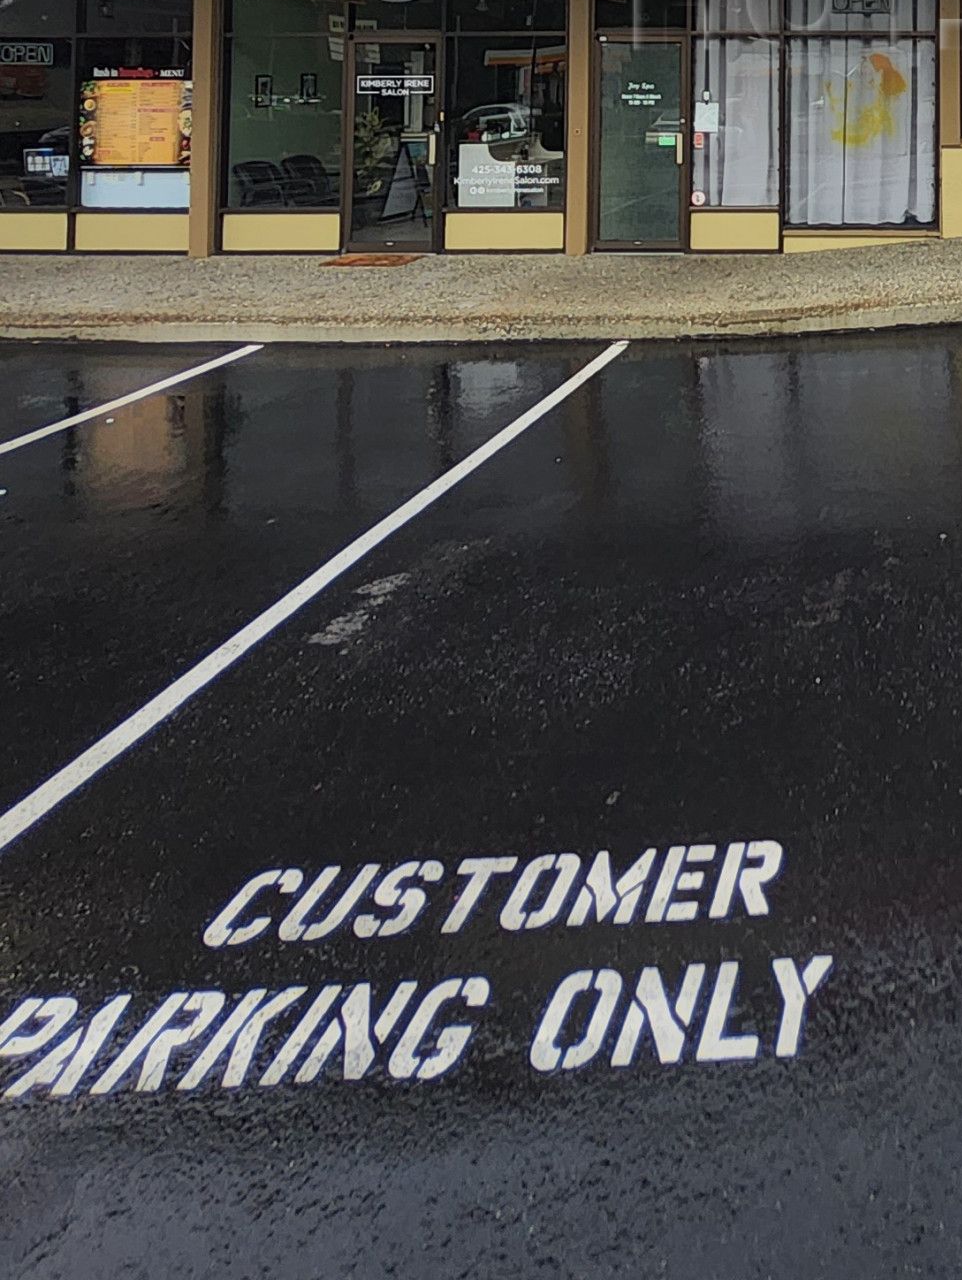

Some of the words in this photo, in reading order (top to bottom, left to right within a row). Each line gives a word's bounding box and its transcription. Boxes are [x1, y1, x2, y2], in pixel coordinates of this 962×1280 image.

[1, 45, 50, 63] OPEN
[160, 68, 185, 77] MENU
[360, 79, 402, 88] KIMBERLY
[403, 79, 430, 88] IRENE
[628, 82, 640, 90] Joy
[381, 88, 410, 97] SALON
[202, 838, 784, 948] CUSTOMER
[0, 974, 491, 1099] PARKING
[529, 953, 835, 1073] ONLY
